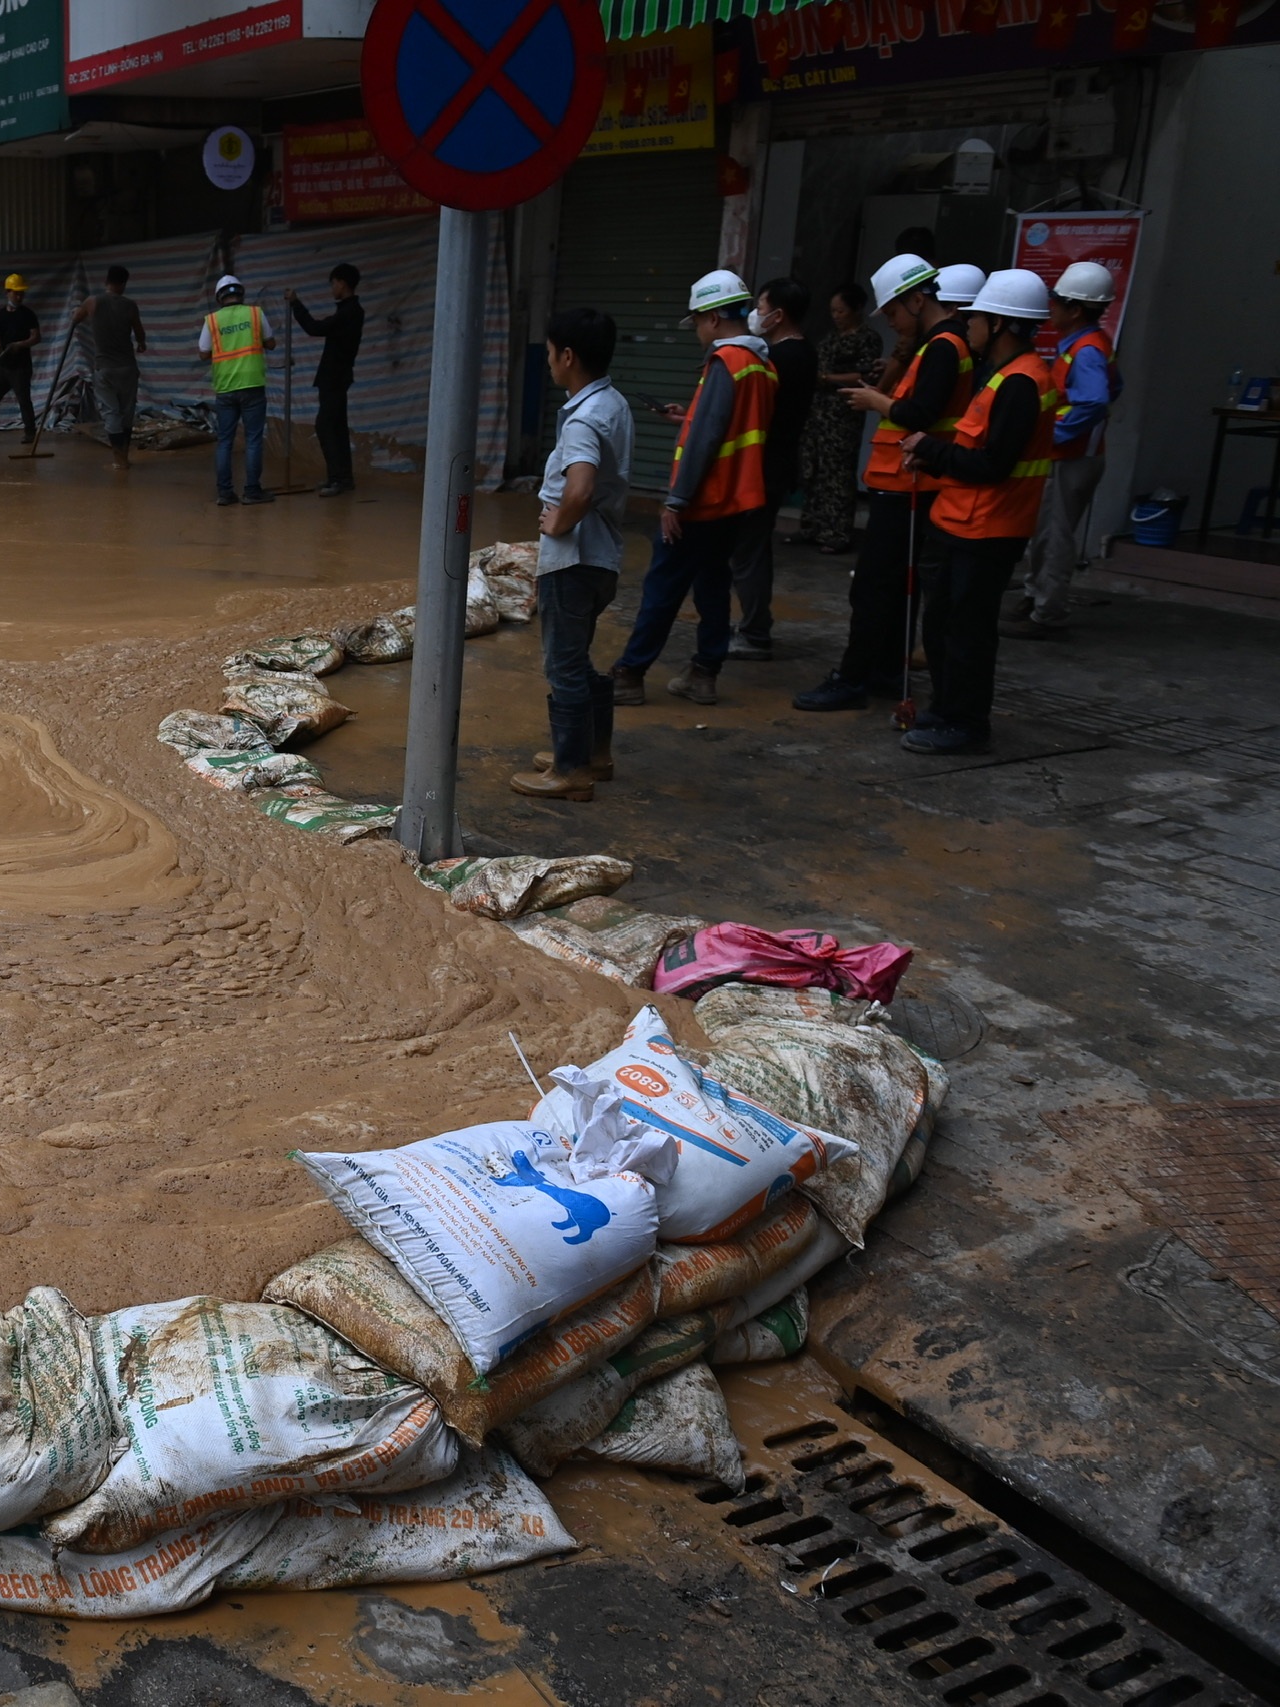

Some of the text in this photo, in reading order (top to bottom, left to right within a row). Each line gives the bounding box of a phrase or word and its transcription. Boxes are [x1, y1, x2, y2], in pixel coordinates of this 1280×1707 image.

[617, 1062, 666, 1095] G802
[340, 1154, 392, 1205] SẢN PHẨM CỦA:
[480, 1197, 490, 1207] 25
[420, 1156, 440, 1176] CÔNG
[435, 1172, 447, 1183] TY
[442, 1179, 463, 1198] TNHH
[475, 1210, 494, 1230] HÒA
[489, 1226, 511, 1249] PHÁT
[505, 1246, 528, 1272] HƯNG
[522, 1269, 539, 1289] YÊN
[429, 1181, 443, 1195] KHU
[444, 1197, 459, 1212] KCN
[482, 1237, 495, 1250] XÃ
[441, 1207, 460, 1227] HƯNG
[467, 1235, 485, 1253] VIỆT
[480, 1249, 497, 1267] NAM
[421, 1237, 493, 1317] TẬP ĐOÀN HÒA PHÁT
[138, 1395, 158, 1429] DỤNG
[292, 1388, 307, 1420] Không
[450, 1508, 474, 1530] 29
[38, 1570, 76, 1601] GÀ
[76, 1568, 139, 1596] LÔNG
[130, 1530, 206, 1584] TRẮNG
